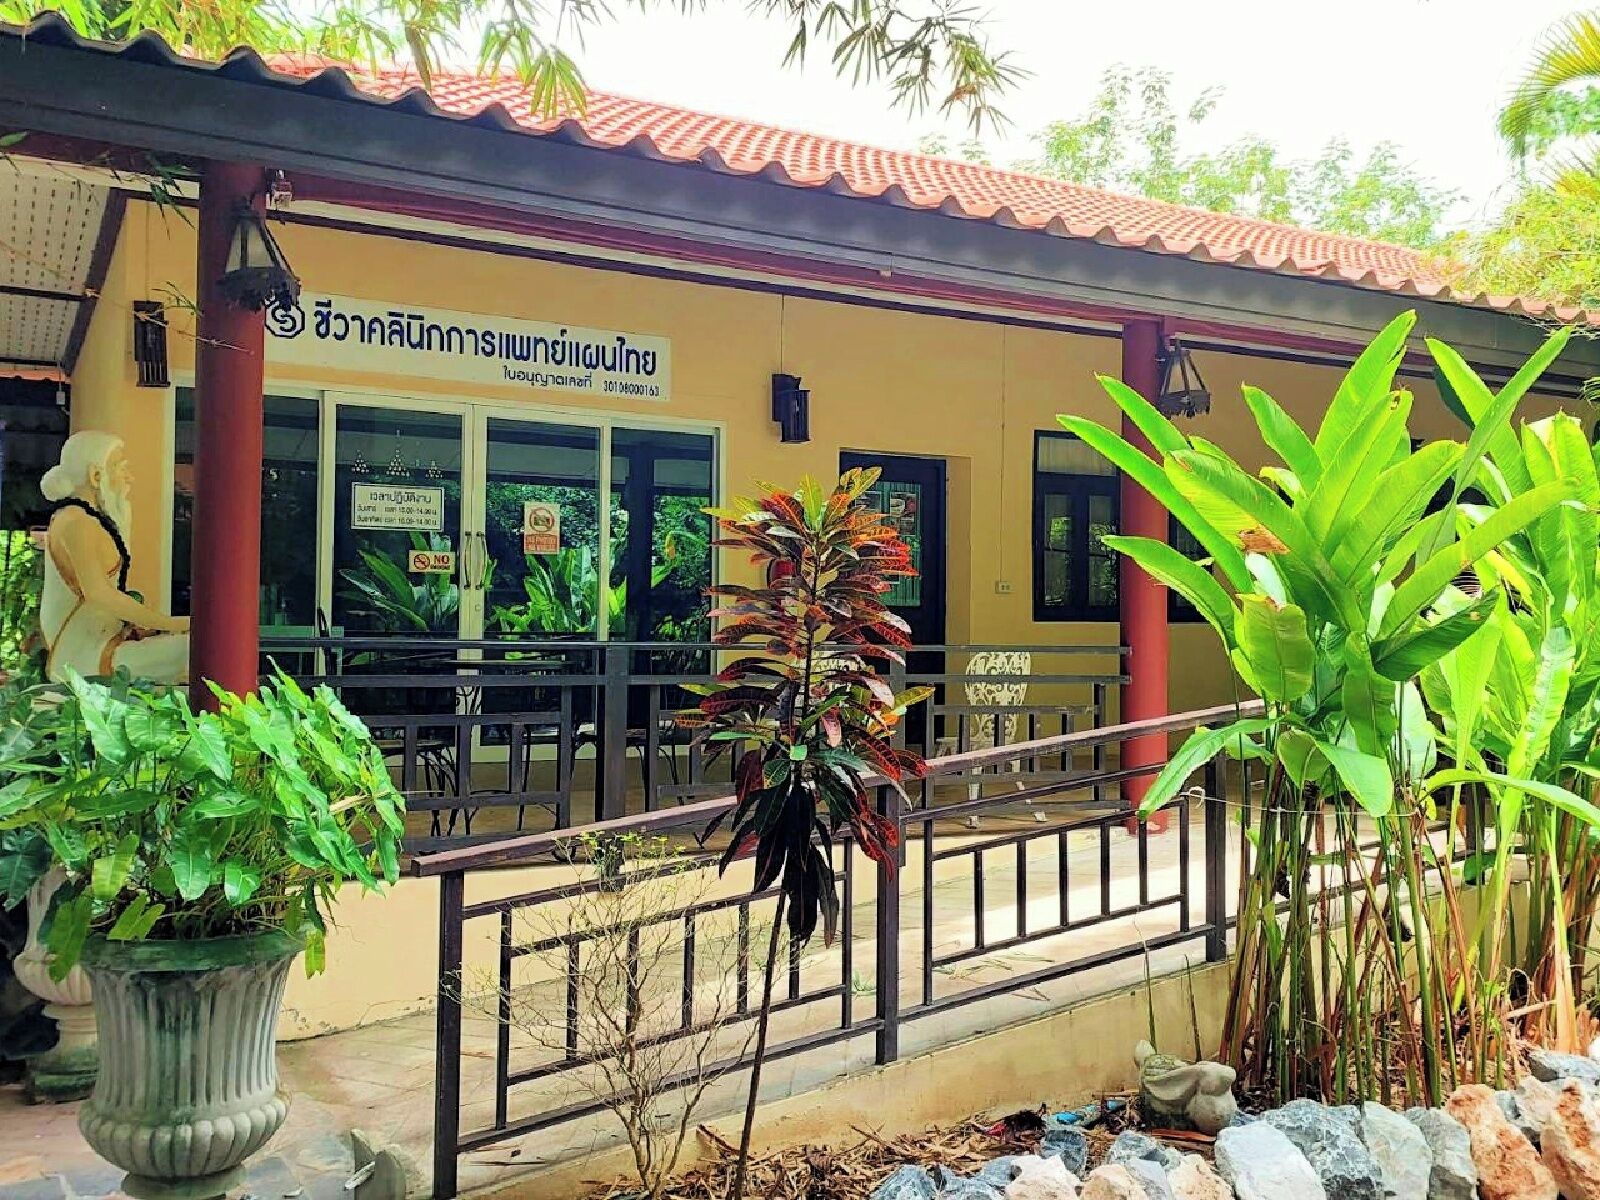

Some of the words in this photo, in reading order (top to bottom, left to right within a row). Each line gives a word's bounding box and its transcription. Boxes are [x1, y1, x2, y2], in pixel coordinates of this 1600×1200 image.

[314, 299, 656, 376] ชีวาคลินิกการแพทย์แผนไทย
[503, 365, 592, 388] ใบอนุญาตเลขที่
[434, 554, 450, 564] NO
